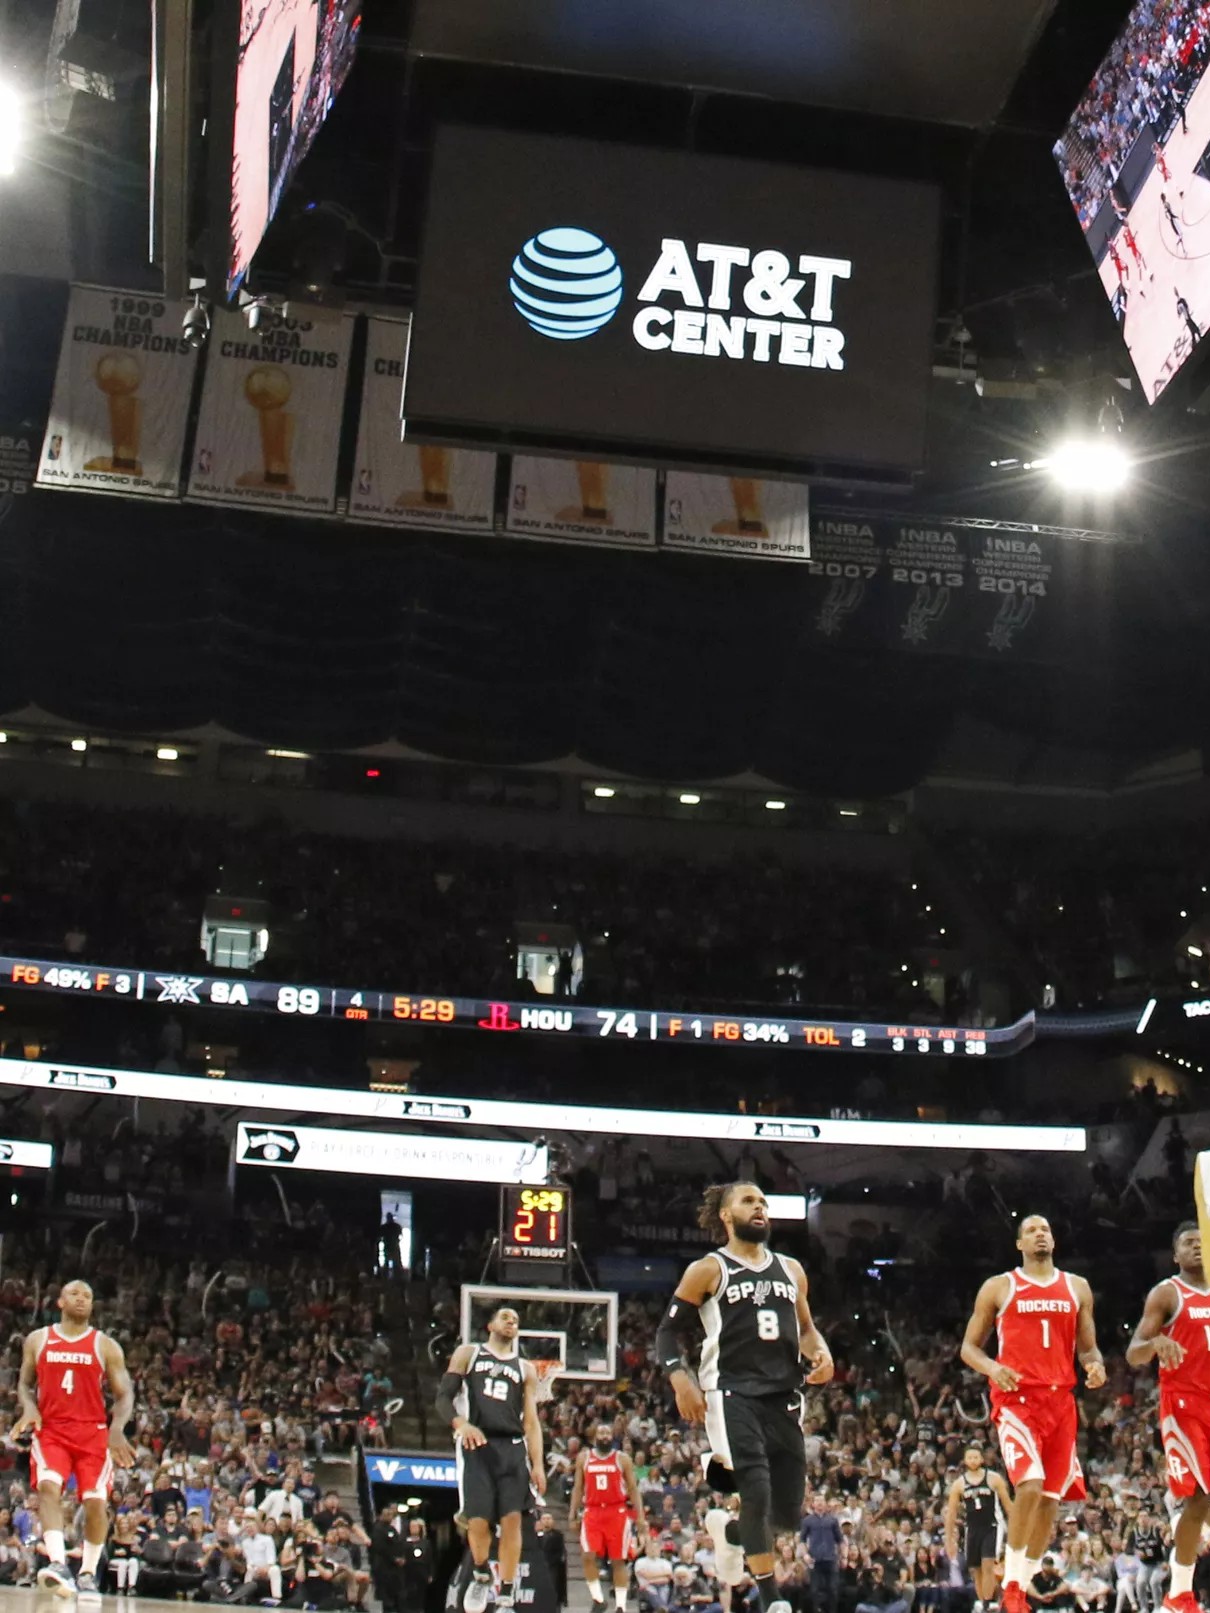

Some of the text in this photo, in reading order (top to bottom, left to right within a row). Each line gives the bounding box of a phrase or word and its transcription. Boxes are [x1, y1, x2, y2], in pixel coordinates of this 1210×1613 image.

[637, 238, 852, 321] AT&T
[111, 297, 165, 318] 1999
[113, 314, 153, 334] NBA
[73, 325, 191, 356] CHAMPIONS
[632, 305, 846, 370] CENTER
[221, 340, 338, 368] CHAMPIONS
[42, 468, 69, 479] SAN
[73, 471, 130, 485] ANTONIO
[513, 517, 541, 529] SAN
[545, 521, 602, 536] ANTONIO
[826, 521, 874, 538] NBA
[668, 532, 805, 553] SAN ANTONIO SPURS
[908, 529, 957, 545] NBA
[994, 538, 1042, 555] NBA
[809, 562, 877, 579] 2007
[892, 567, 964, 587] 2013
[979, 575, 1048, 596] 2014
[12, 964, 320, 1015] FG 49% F 3 SA 89
[350, 992, 362, 1007] 4
[393, 996, 455, 1021] 5:29
[520, 1008, 572, 1031] HOU
[596, 1011, 638, 1039] 74
[669, 1019, 682, 1037] F
[690, 1019, 703, 1039] 1
[713, 1021, 740, 1040] FG
[743, 1023, 789, 1044] 34%
[803, 1026, 840, 1047] TOL
[851, 1028, 867, 1048] 2
[887, 1026, 908, 1037] BLK
[913, 1028, 933, 1038] STL
[938, 1030, 958, 1040] AST
[892, 1037, 904, 1052] 3
[918, 1038, 930, 1053] 3
[521, 1189, 563, 1212] 5:29
[513, 1210, 557, 1242] 21
[522, 1246, 566, 1259] TISSOT
[1016, 1299, 1071, 1314] ROCKETS
[756, 1309, 781, 1341] 8
[1041, 1319, 1050, 1349] 1
[46, 1350, 93, 1366] ROCKETS
[61, 1369, 75, 1394] 4
[483, 1377, 509, 1401] 12
[410, 1465, 456, 1481] VALE
